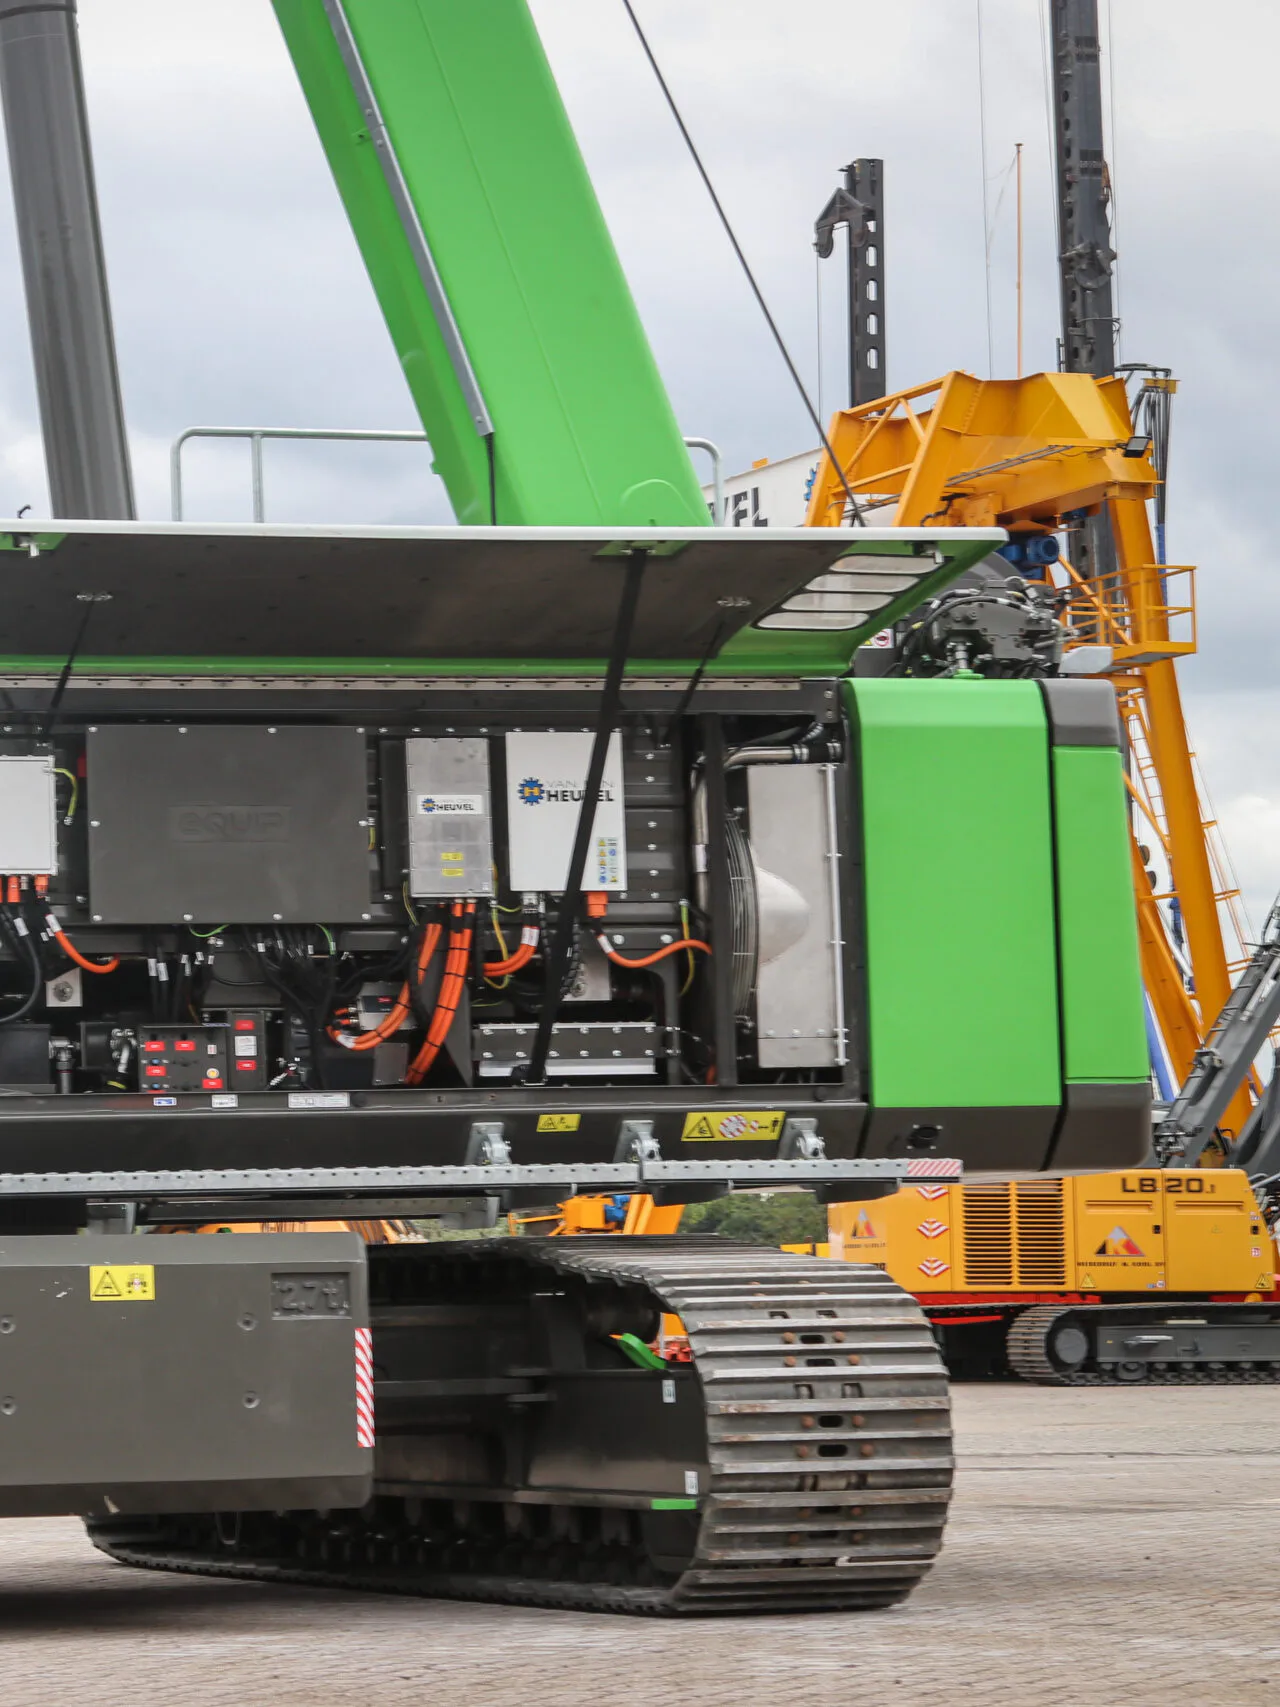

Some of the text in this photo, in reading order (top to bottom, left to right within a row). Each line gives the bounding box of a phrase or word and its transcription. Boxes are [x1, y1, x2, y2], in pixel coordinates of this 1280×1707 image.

[546, 789, 615, 802] HEUEL
[436, 803, 474, 811] HEUVEL
[1122, 1177, 1157, 1193] LB
